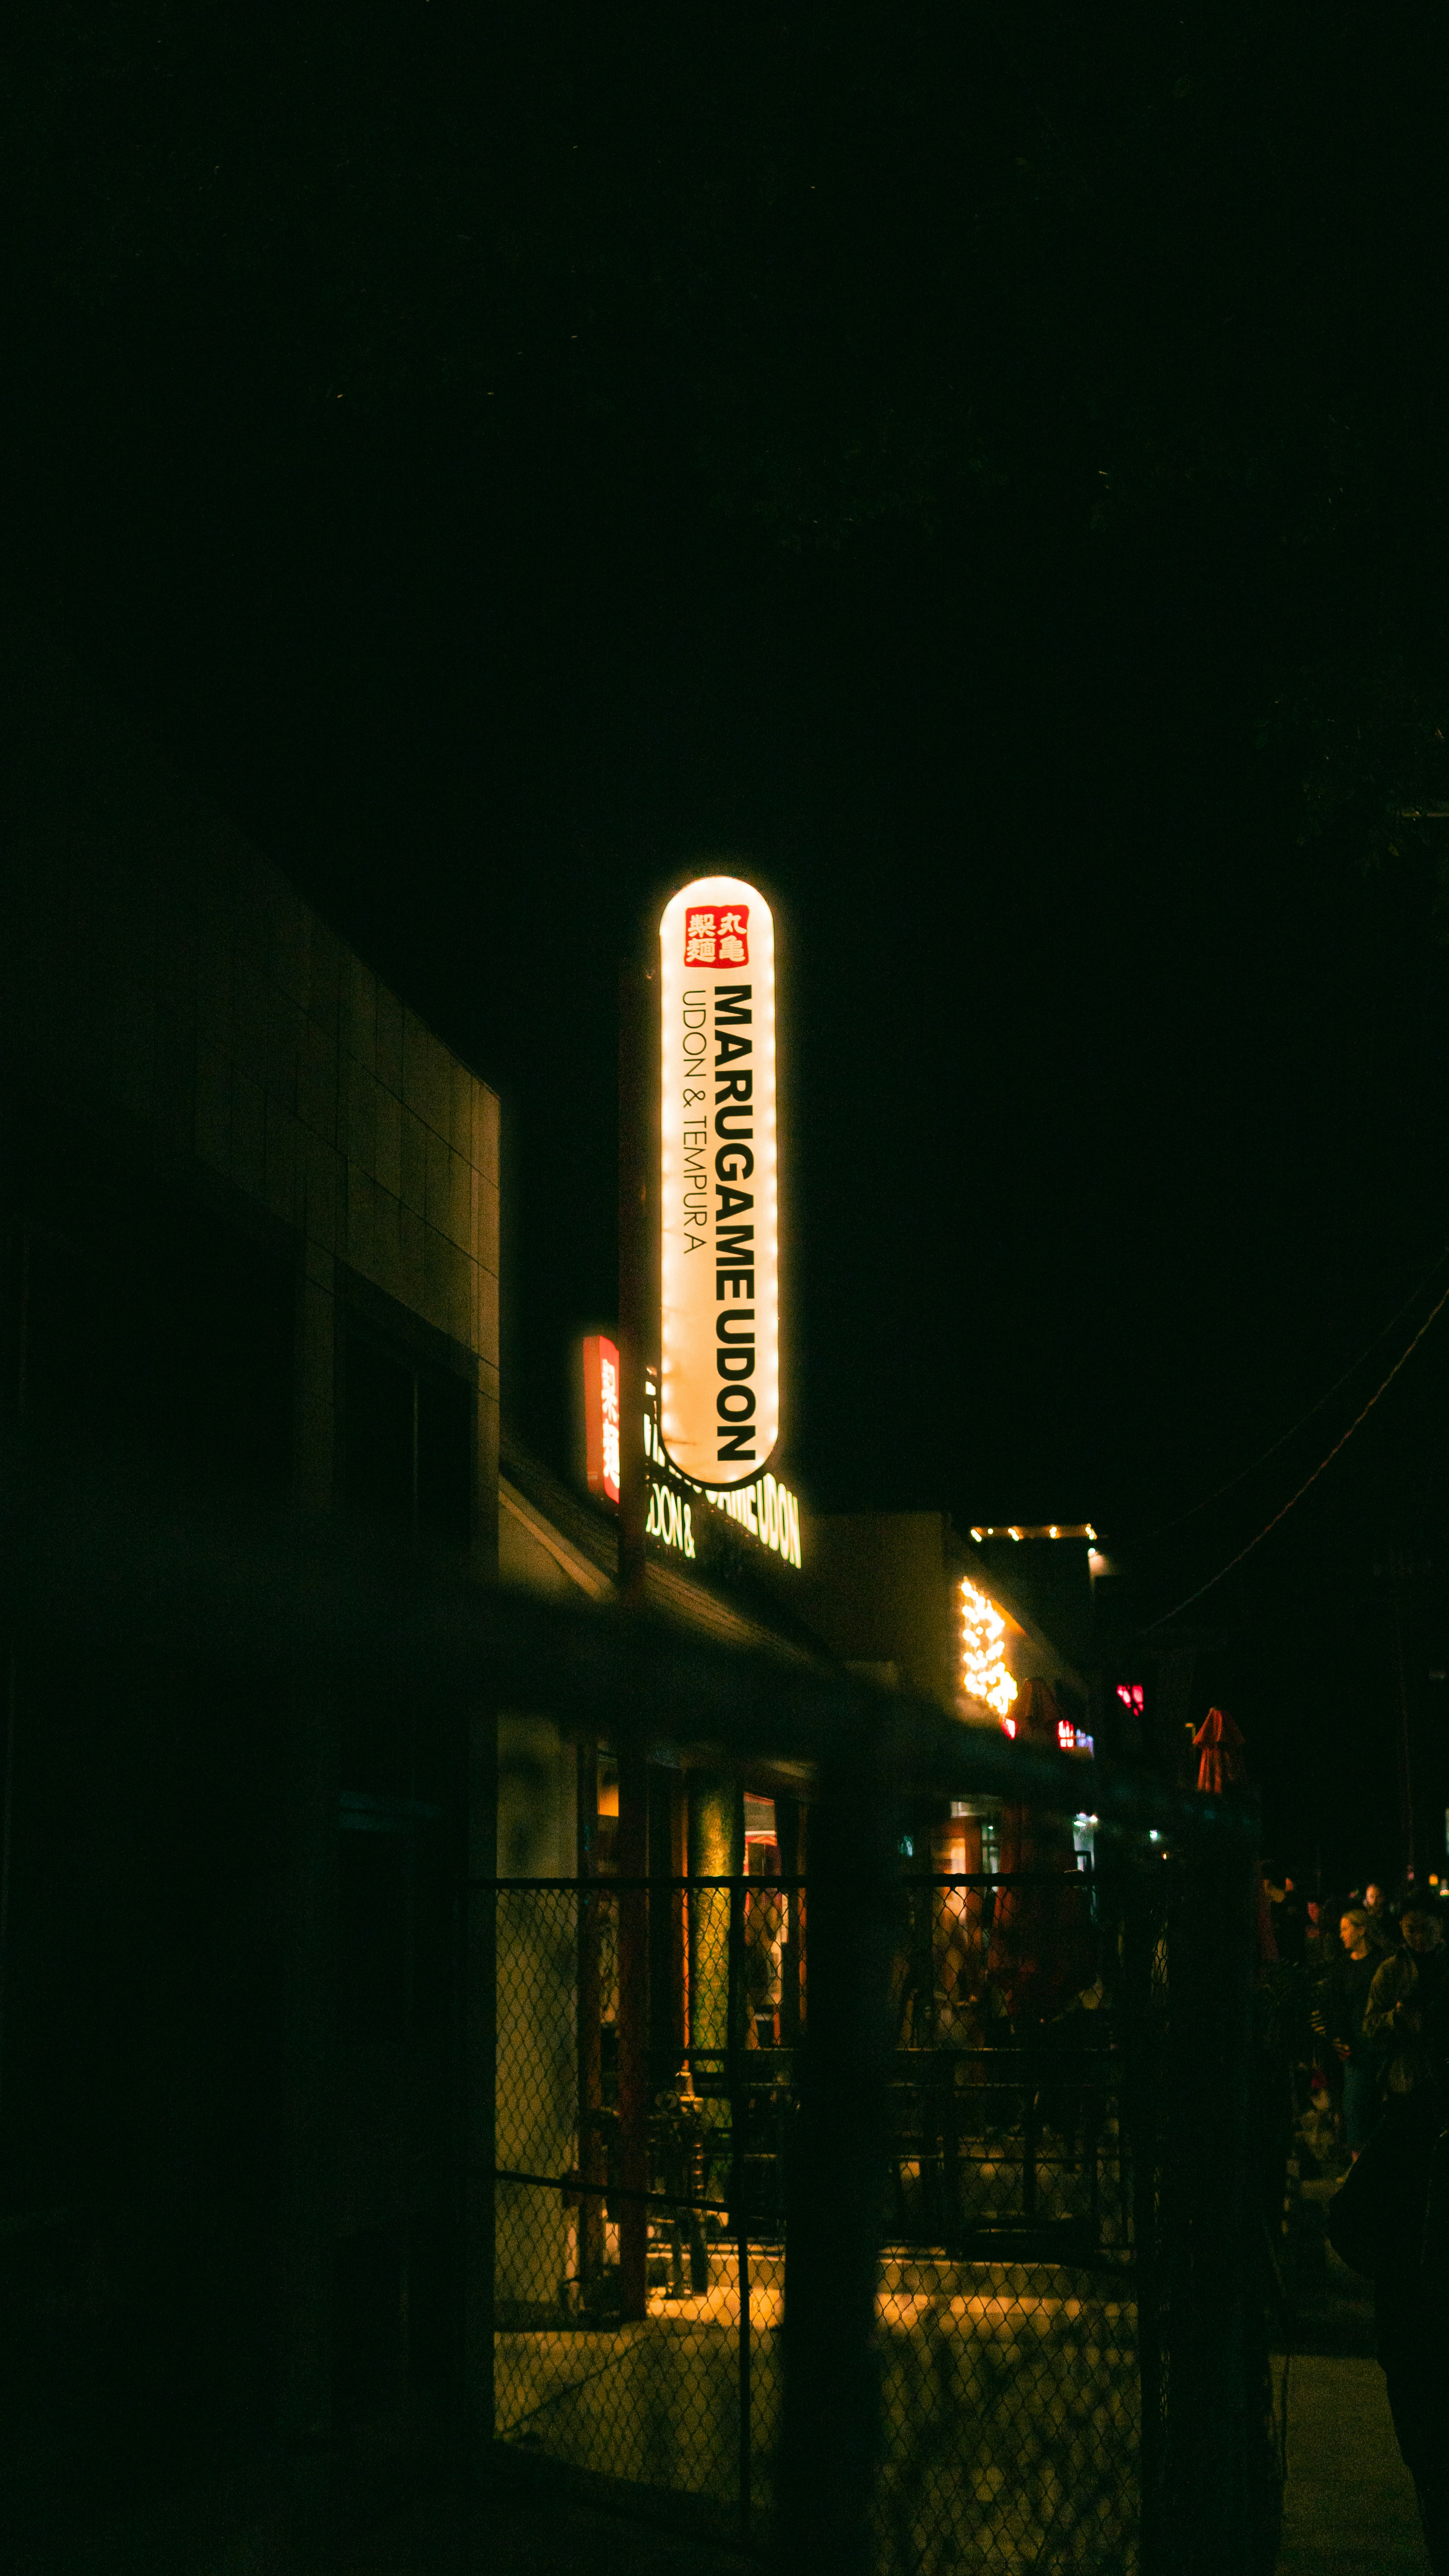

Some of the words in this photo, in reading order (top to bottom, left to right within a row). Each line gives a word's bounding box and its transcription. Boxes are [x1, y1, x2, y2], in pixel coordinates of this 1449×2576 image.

[686, 913, 717, 963] 製麺
[717, 912, 747, 962] 丸亀
[682, 990, 707, 1077] UDON
[682, 1088, 706, 1108] &
[714, 984, 755, 1301] MARUGAME
[683, 1115, 707, 1254] TEMPURA
[716, 1308, 757, 1462] UDON
[683, 1503, 696, 1559] &
